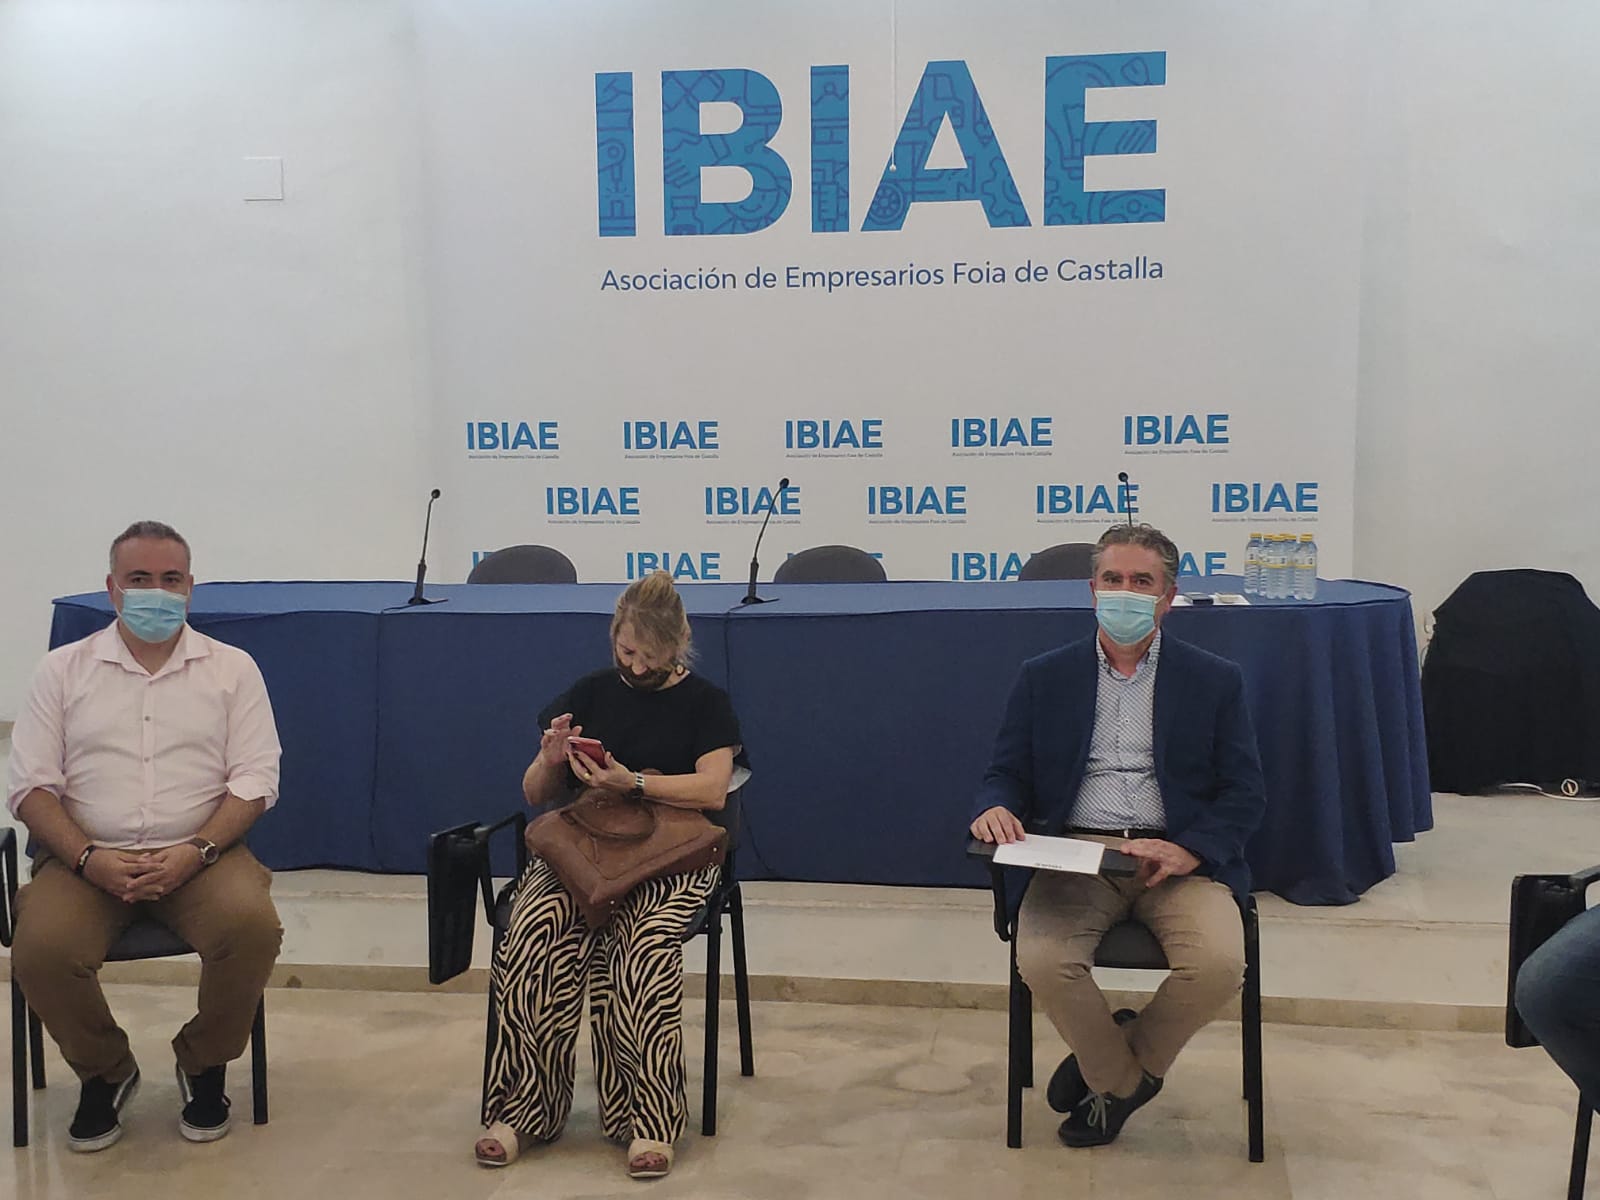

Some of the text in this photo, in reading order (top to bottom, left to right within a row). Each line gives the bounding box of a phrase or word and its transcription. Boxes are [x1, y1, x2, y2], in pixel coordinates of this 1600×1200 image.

[596, 51, 1166, 237] IBIAE
[601, 256, 1163, 293] Asociación de Empresarios Foia de Castalla
[467, 422, 558, 450] IBIAE
[624, 422, 718, 450] IBIAE
[786, 419, 882, 449] IBIAE
[952, 418, 1052, 447] IBIAE
[1124, 414, 1229, 445] IBIAE
[546, 487, 640, 515] IBIAE
[705, 486, 801, 515] IBIAE
[868, 486, 966, 515] IBIAE
[1036, 484, 1139, 514] IBIAE
[1213, 482, 1319, 513] IBIAE
[951, 552, 1036, 581] IBIA
